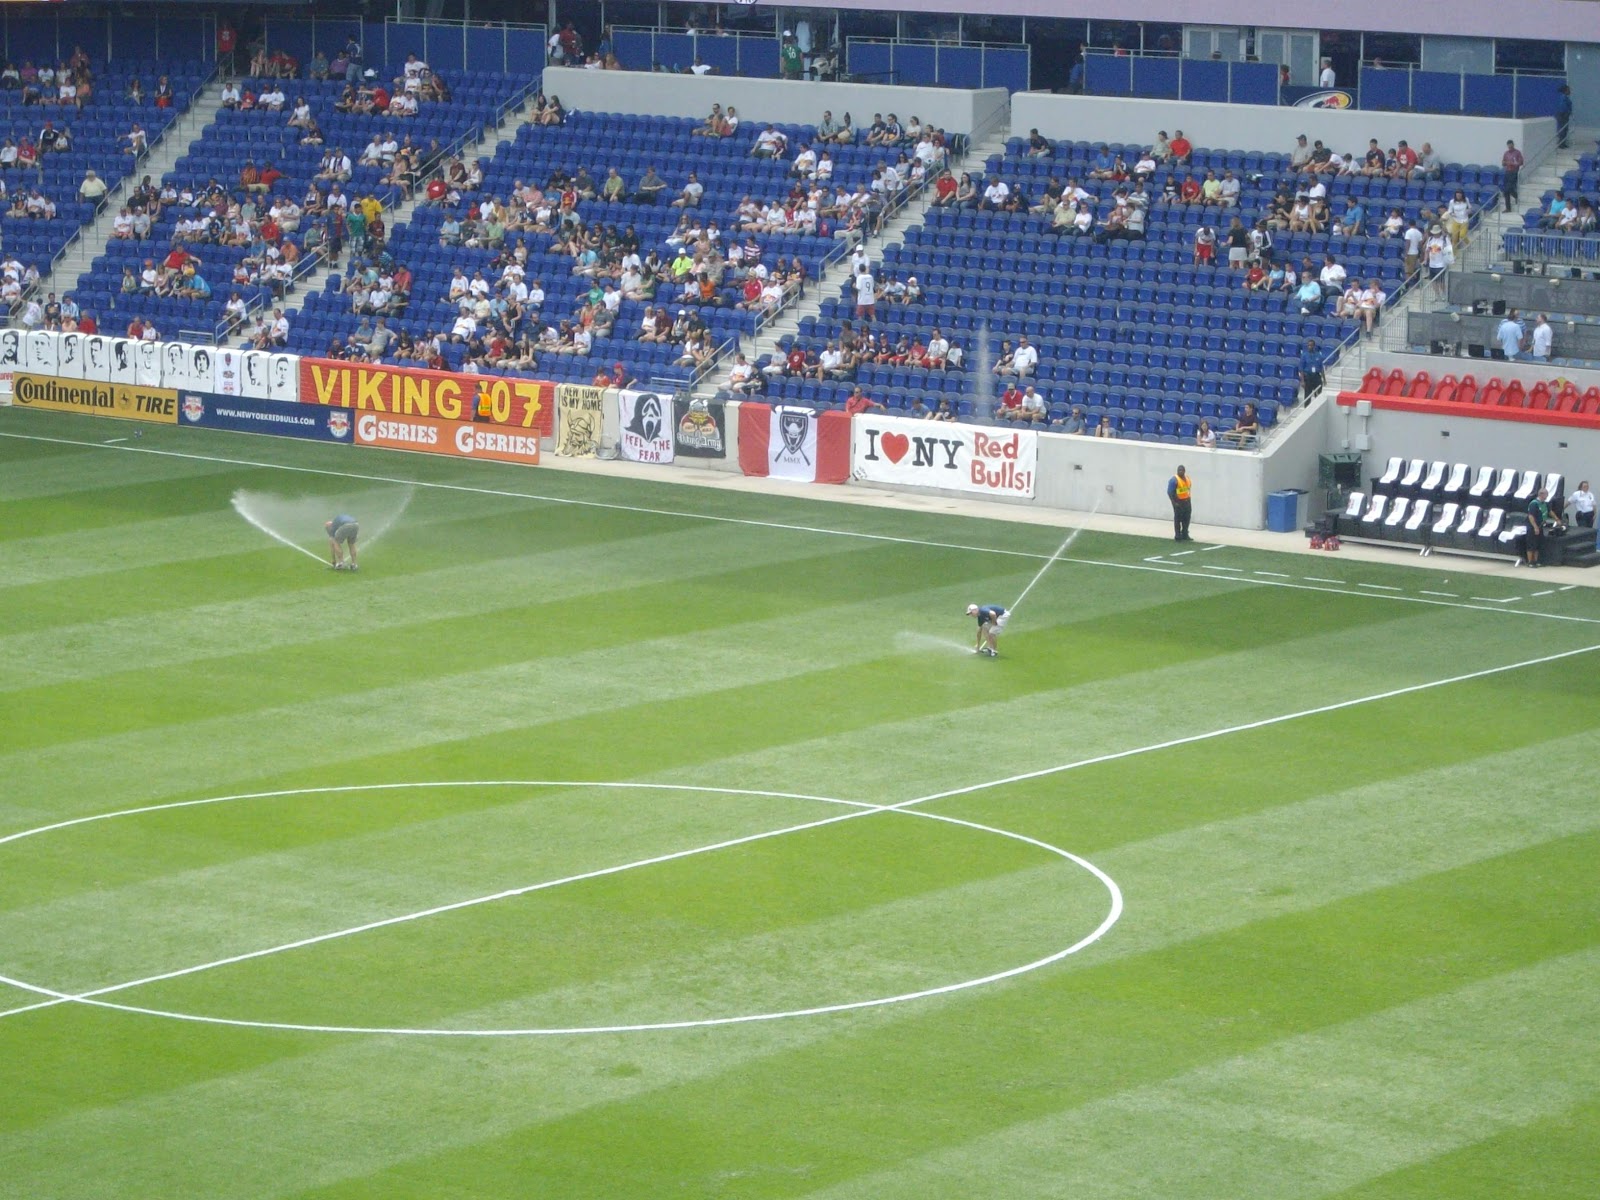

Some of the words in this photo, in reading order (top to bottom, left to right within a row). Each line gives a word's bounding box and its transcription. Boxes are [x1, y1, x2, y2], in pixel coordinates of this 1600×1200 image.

[15, 376, 115, 409] Continental
[135, 394, 176, 416] TIRE
[311, 365, 462, 419] VIKING
[563, 387, 580, 398] NEW
[569, 398, 580, 410] MY
[582, 399, 602, 411] HOME
[216, 408, 315, 426] WWW.NEWYORKREDBULLS.COM
[624, 433, 644, 448] FEEL
[652, 439, 671, 451] THE
[865, 429, 880, 461] I
[912, 437, 964, 469] NY
[974, 432, 1018, 459] Red
[639, 449, 660, 462] FEAR
[783, 456, 801, 464] MMX
[971, 460, 1032, 494] Bulls!
